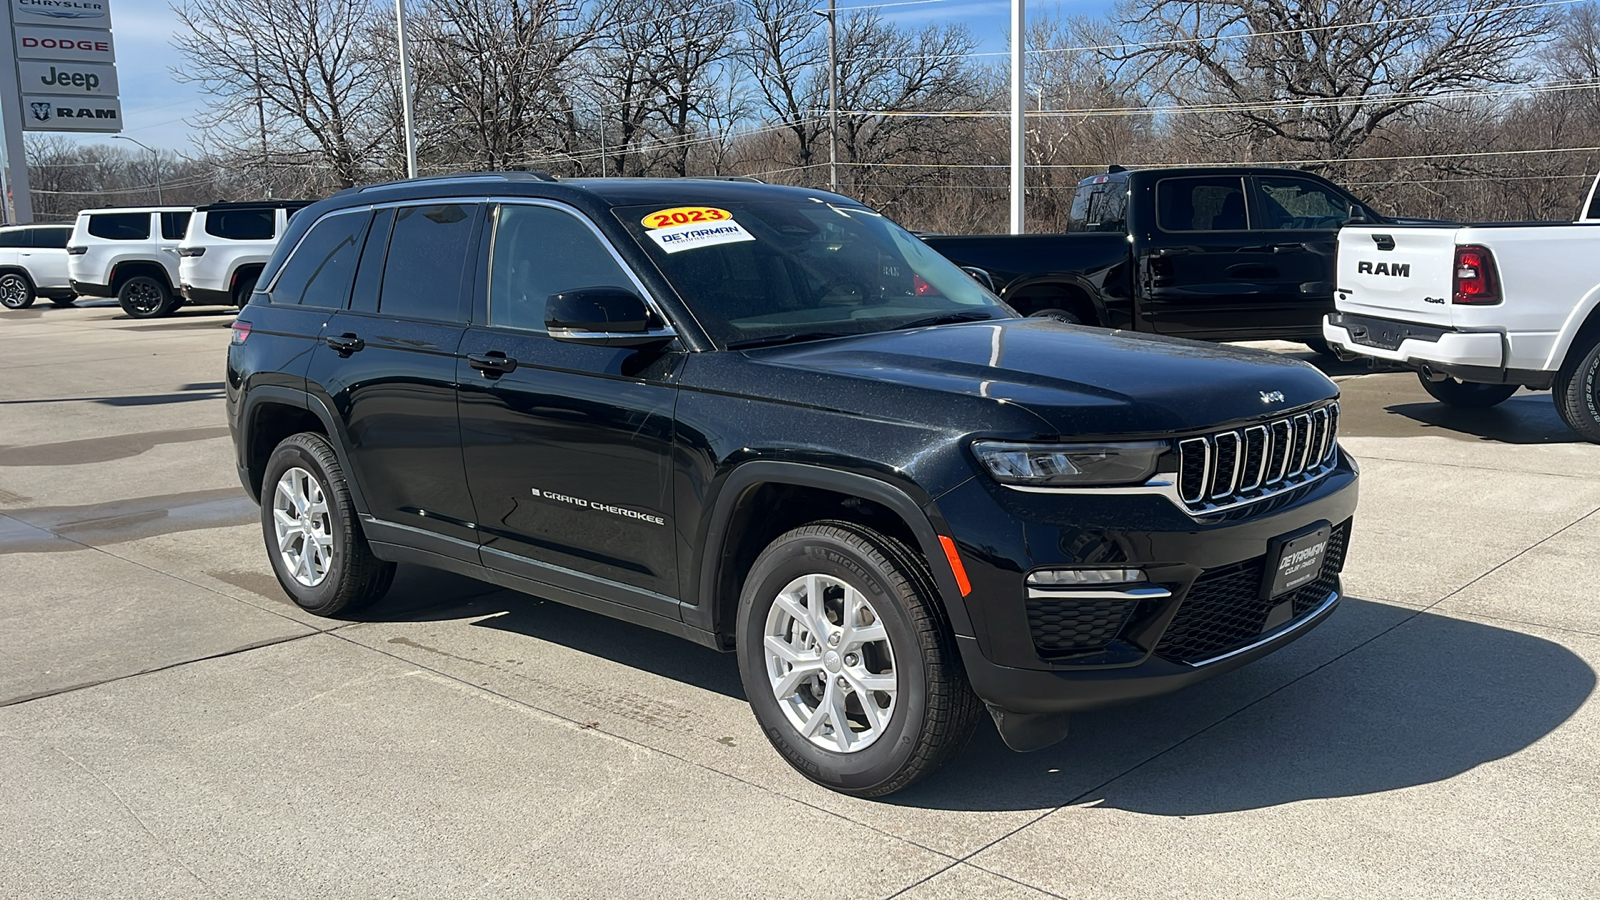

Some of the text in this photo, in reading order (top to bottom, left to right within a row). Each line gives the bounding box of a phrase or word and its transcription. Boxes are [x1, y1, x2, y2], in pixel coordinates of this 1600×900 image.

[20, 0, 102, 10] CHRYSLER
[22, 37, 109, 52] DODGE
[41, 66, 100, 91] Jeep
[56, 107, 117, 119] RAM
[653, 209, 724, 228] 2023
[661, 226, 739, 243] DEYARMAN
[1358, 261, 1410, 278] RAM
[543, 491, 665, 526] GRAND CHEROKEE
[1278, 541, 1327, 570] DEYARMAN
[828, 552, 882, 595] MICHELIN
